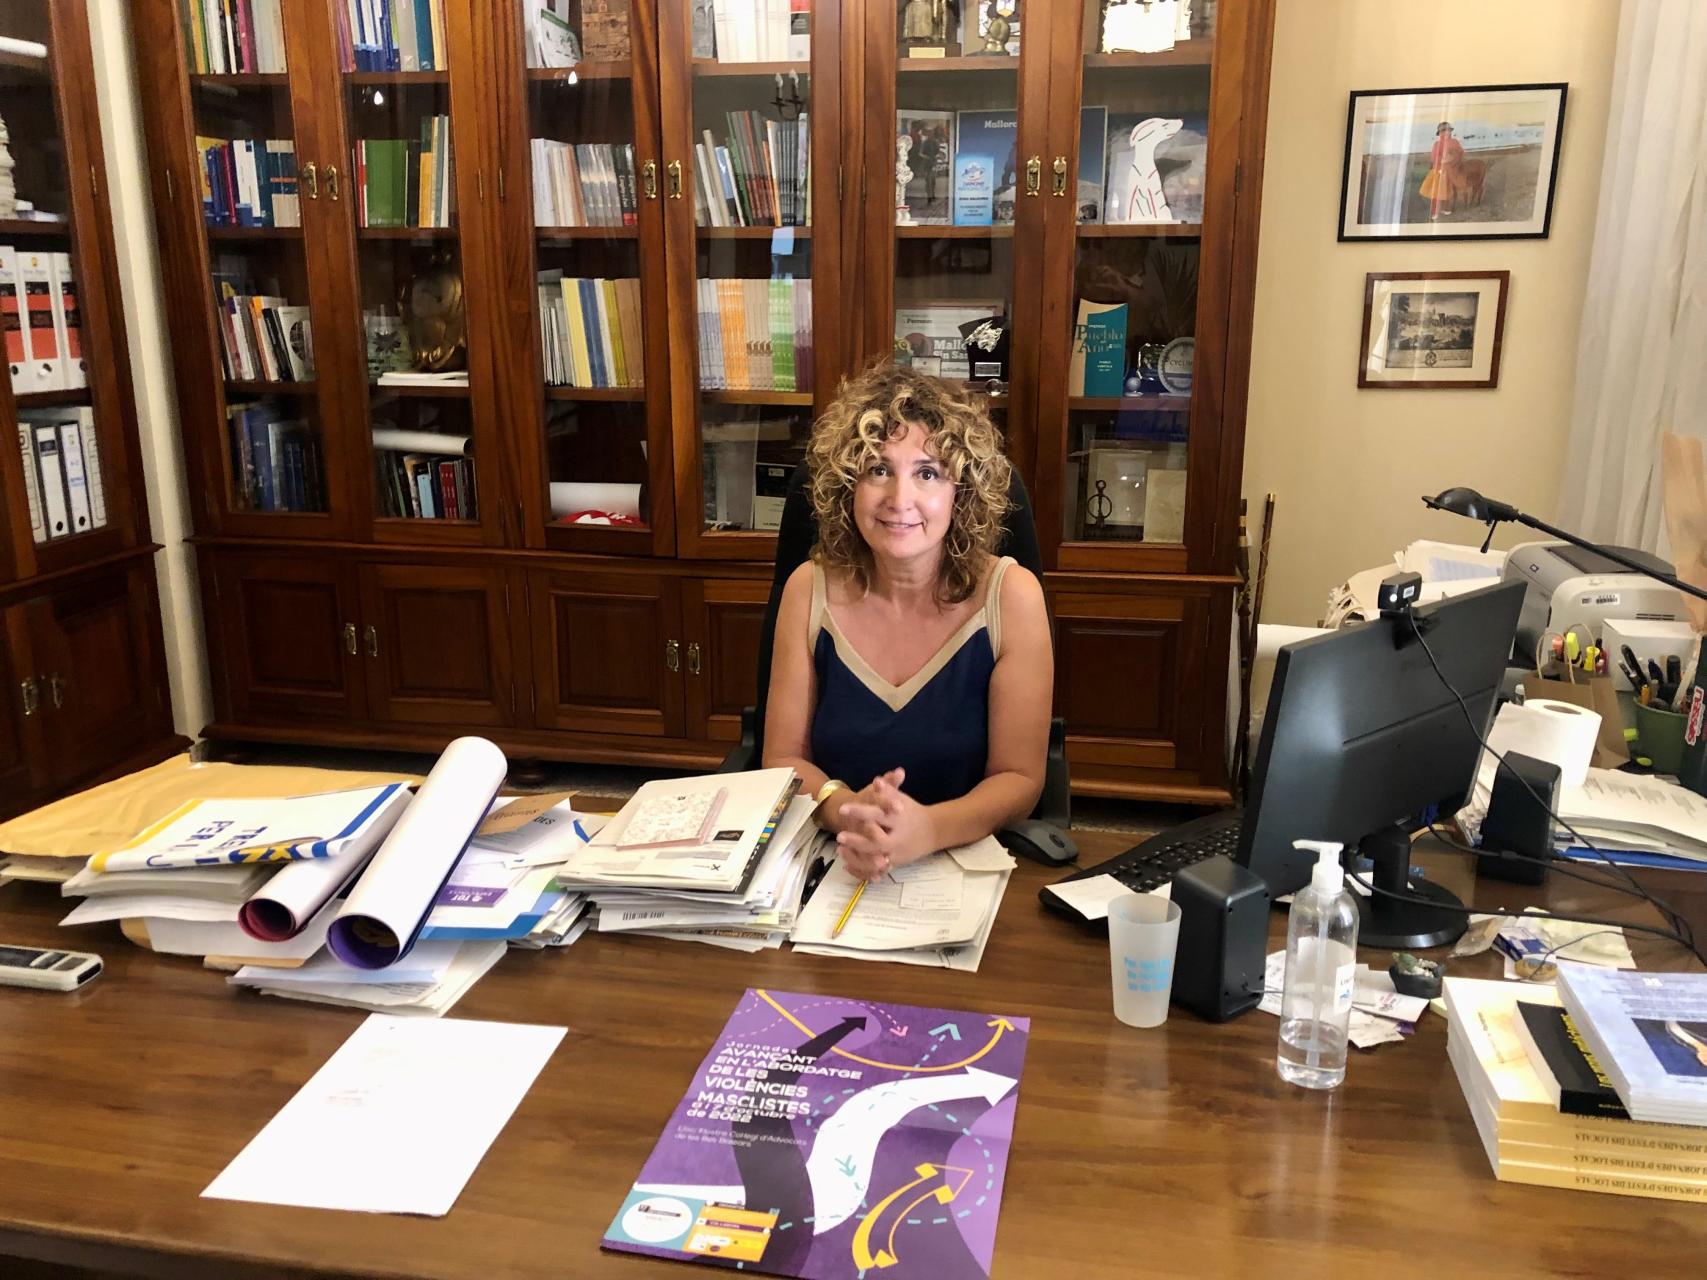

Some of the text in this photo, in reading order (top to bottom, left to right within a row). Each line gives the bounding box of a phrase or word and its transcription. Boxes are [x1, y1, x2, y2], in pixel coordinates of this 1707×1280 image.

[725, 1040, 799, 1055] Jornades
[720, 1047, 817, 1065] AVANÇANT
[708, 1063, 769, 1080] DE LES
[714, 1055, 863, 1081] EN L'ABORDATGE
[704, 1075, 809, 1098] VIOLÈNCIES
[696, 1091, 812, 1115] MASCLISTES
[686, 1108, 752, 1123] de 2022
[1575, 1133, 1609, 1144] LOCALS
[1573, 1154, 1608, 1166] LOCALS
[1575, 1176, 1609, 1187] LOCALS
